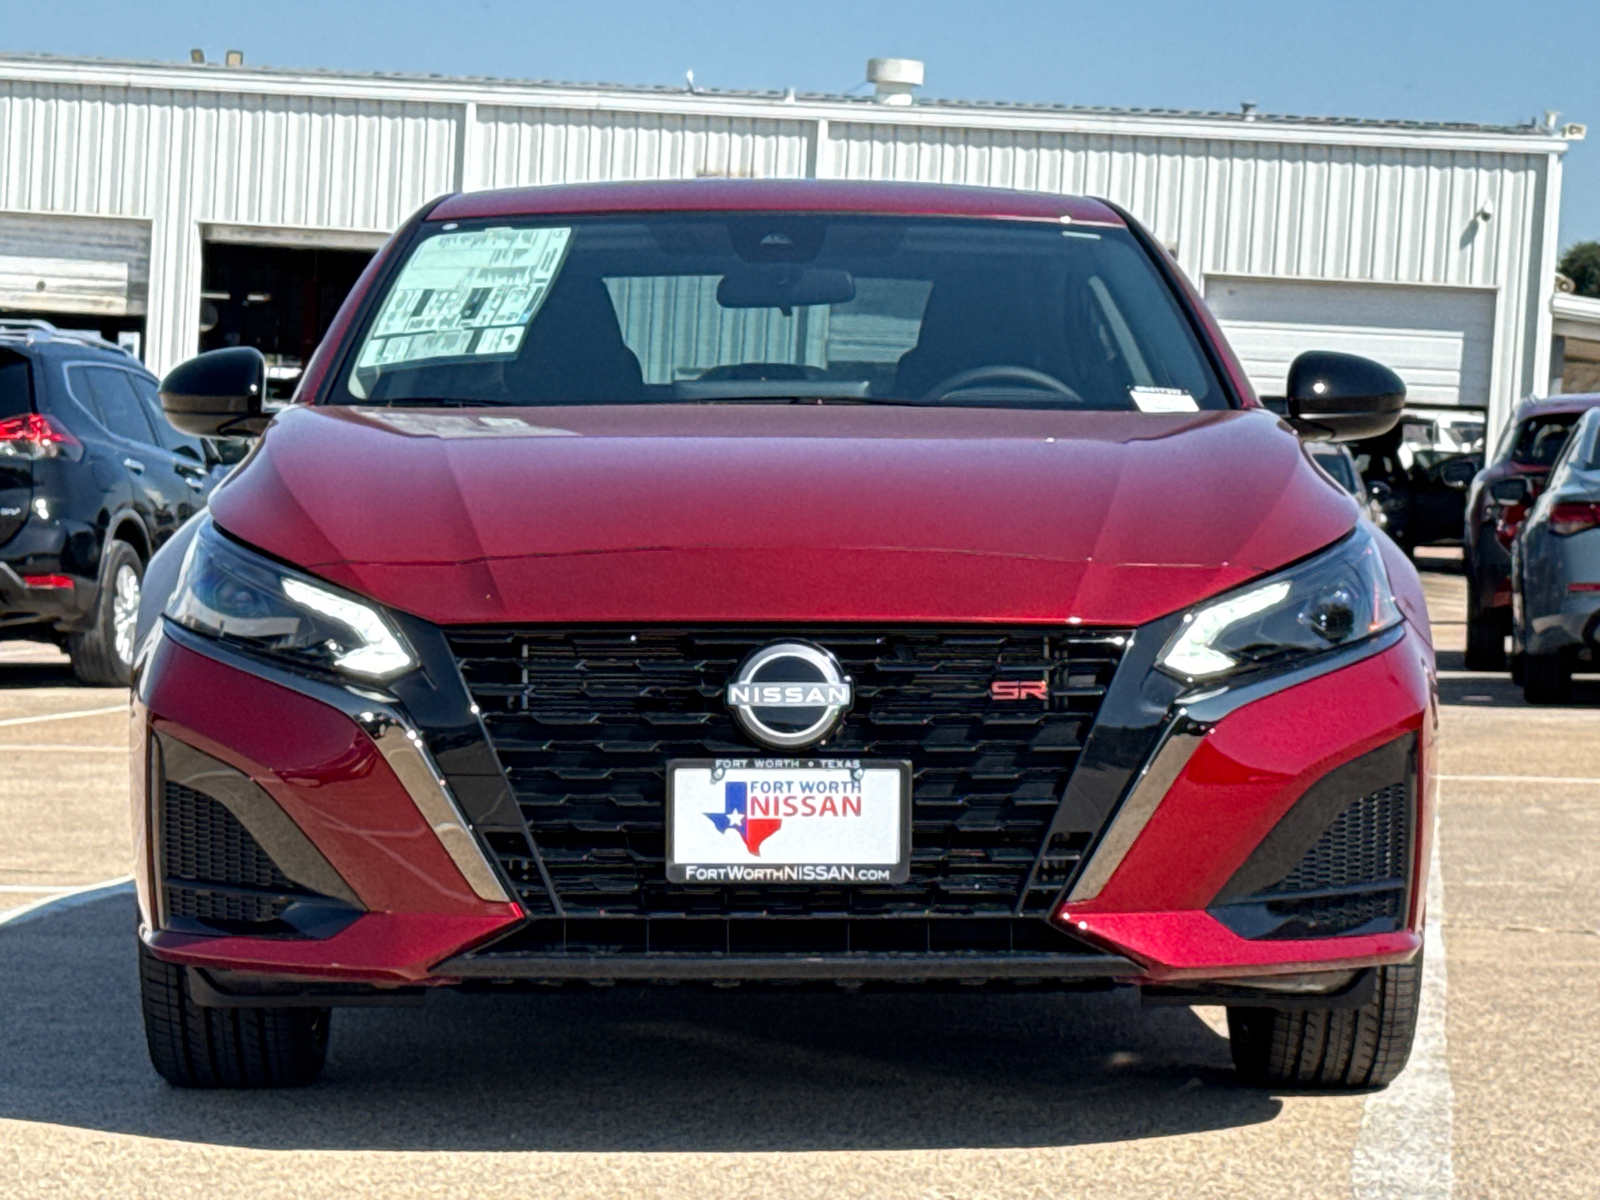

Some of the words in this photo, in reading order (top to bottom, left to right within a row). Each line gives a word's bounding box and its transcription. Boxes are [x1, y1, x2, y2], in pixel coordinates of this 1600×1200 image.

[730, 686, 848, 704] NISSAN
[991, 680, 1048, 701] SR
[715, 759, 748, 769] FORT
[754, 759, 800, 769] WORTH
[819, 759, 861, 769] TEXAS
[750, 781, 795, 794] FORT
[799, 781, 862, 794] WORTH
[750, 795, 862, 817] NISSAN
